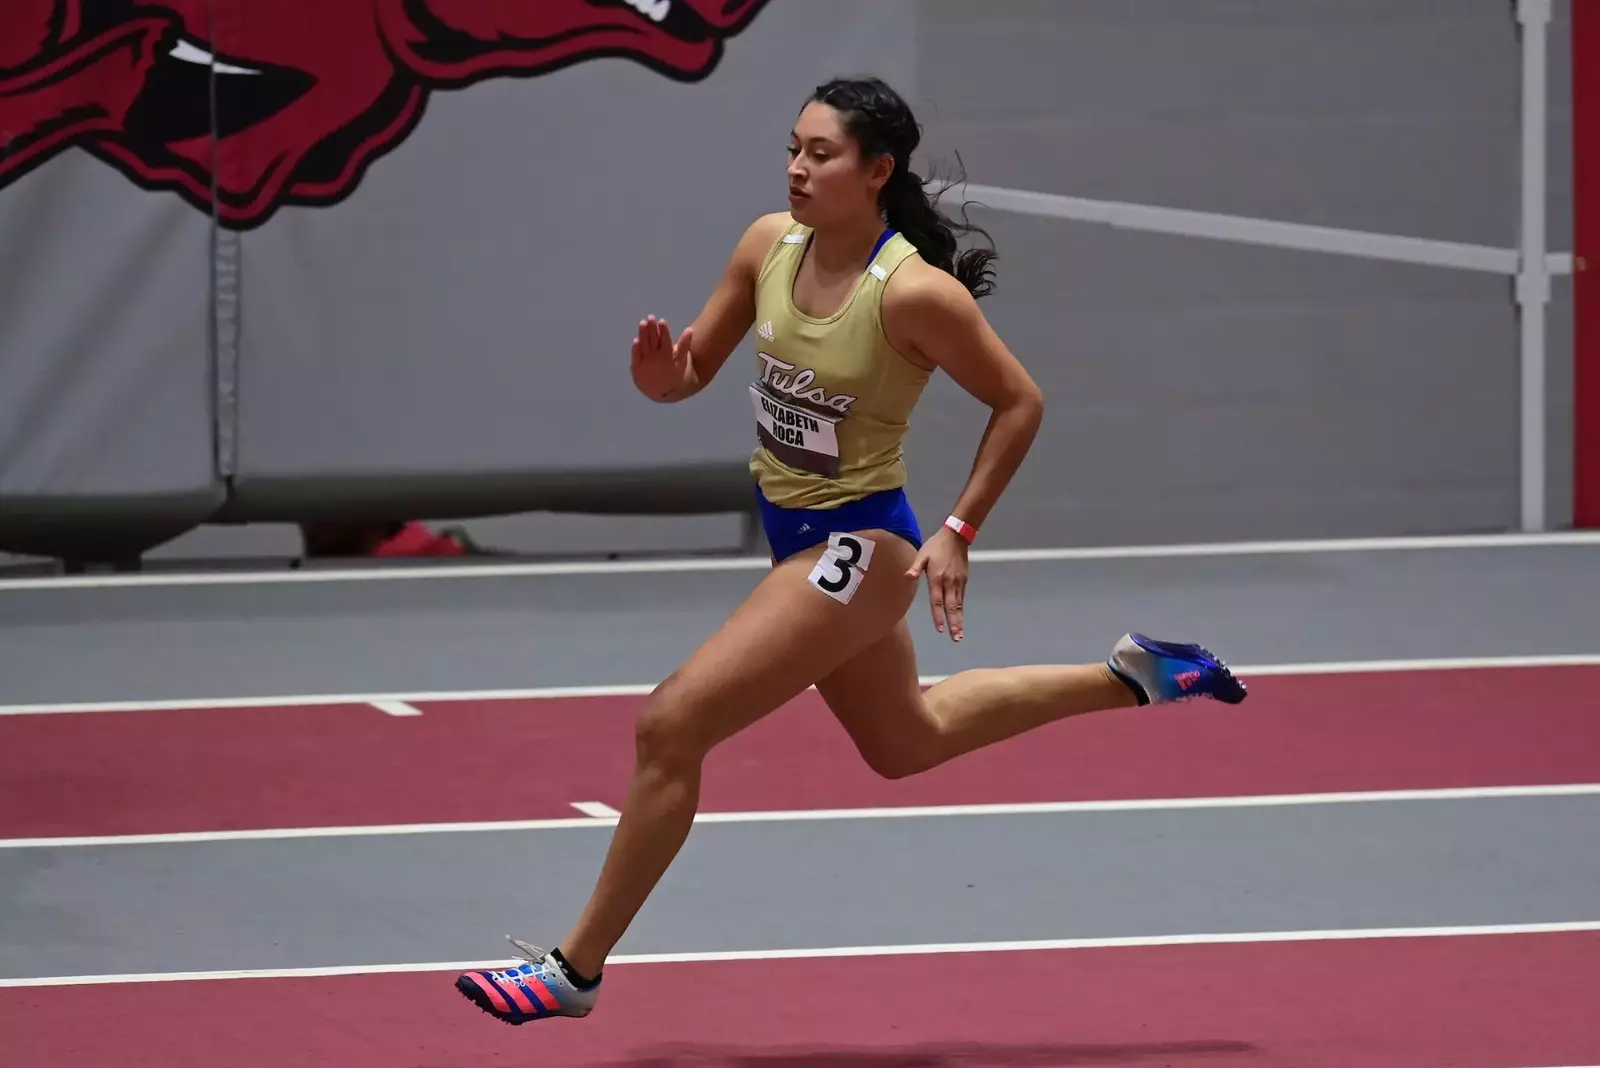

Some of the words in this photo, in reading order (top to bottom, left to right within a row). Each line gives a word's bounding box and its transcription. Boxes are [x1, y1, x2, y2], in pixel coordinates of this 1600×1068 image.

[758, 352, 857, 412] Tulsa
[761, 396, 819, 433] ELIZABETH
[772, 420, 805, 447] ROCA
[817, 537, 862, 593] 3
